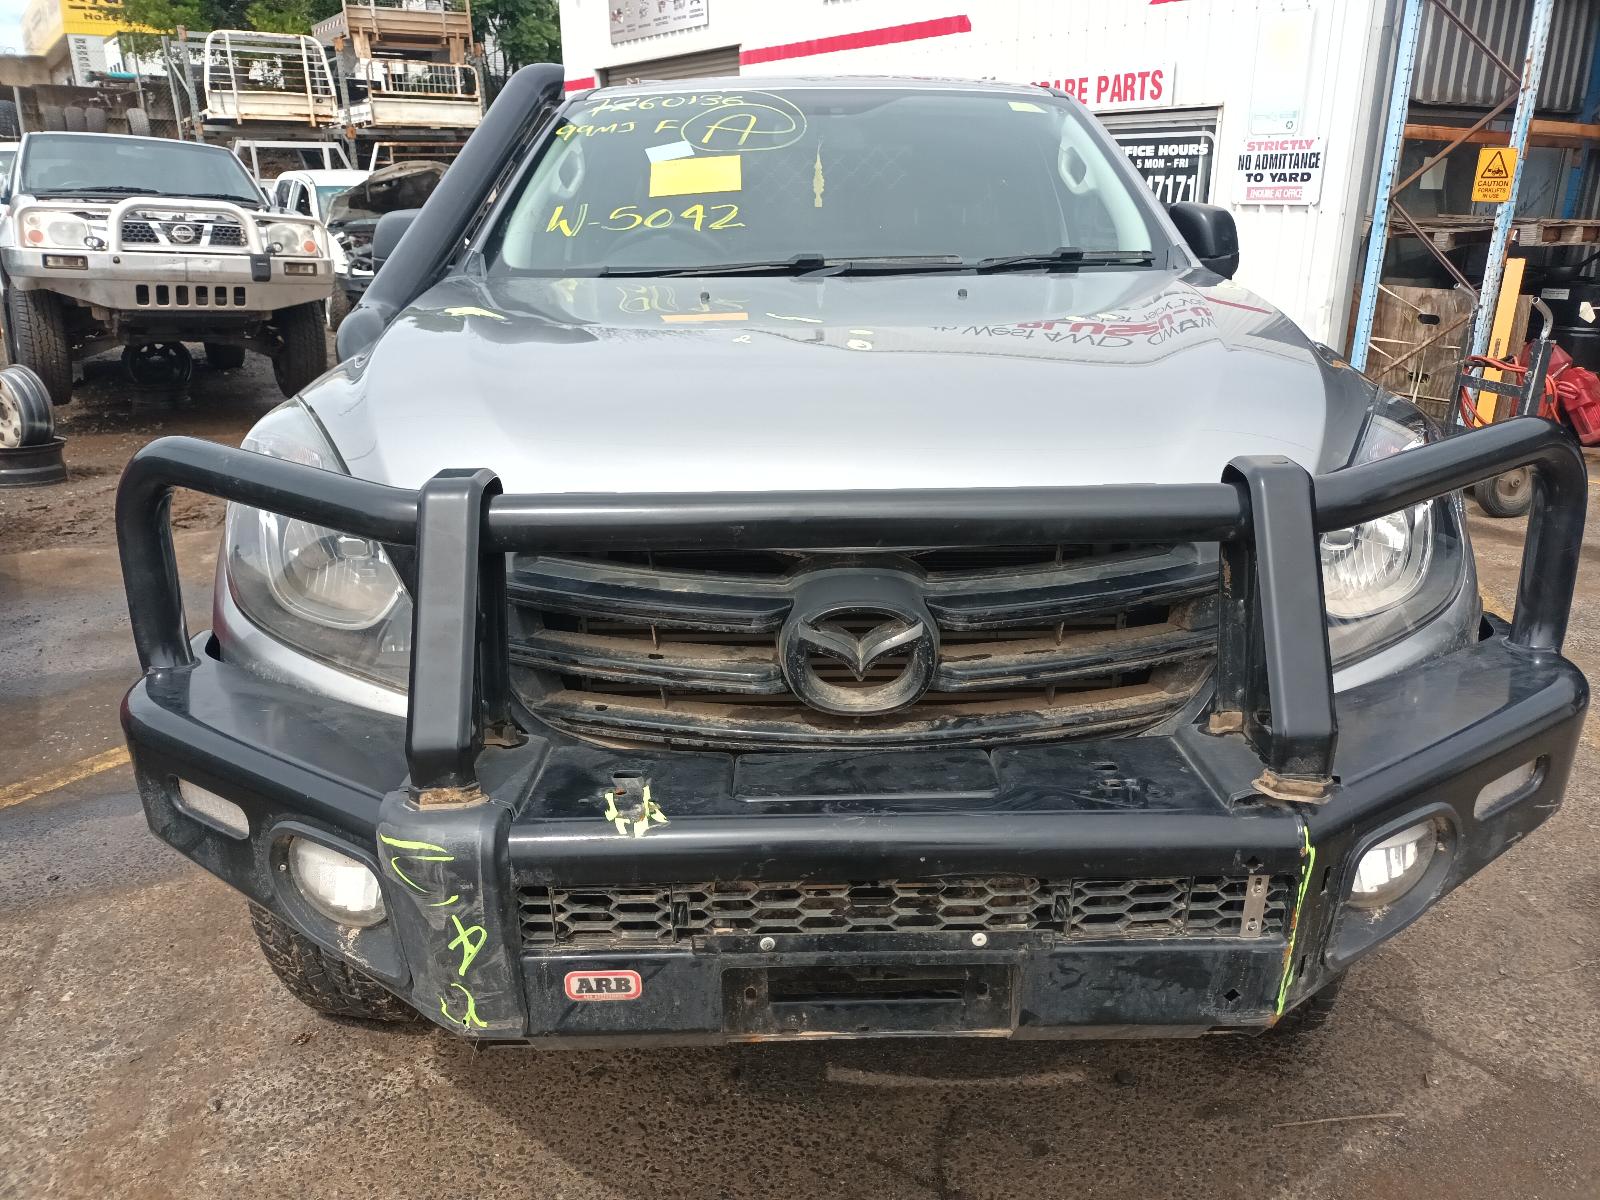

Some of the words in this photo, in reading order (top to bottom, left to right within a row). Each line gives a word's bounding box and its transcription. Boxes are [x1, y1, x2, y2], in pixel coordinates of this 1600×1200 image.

[1030, 77, 1089, 104] ARE
[1096, 69, 1164, 104] PARTS
[1120, 145, 1156, 157] FICE
[1158, 143, 1209, 156] HOURS
[1246, 139, 1315, 152] STRICTLY
[1144, 158, 1165, 169] MON
[1173, 157, 1189, 168] FRI
[1237, 154, 1252, 171] NO
[1254, 151, 1321, 170] ADMITTANCE
[1245, 172, 1264, 183] TO
[1269, 171, 1312, 183] YARD
[576, 977, 633, 994] ARB
